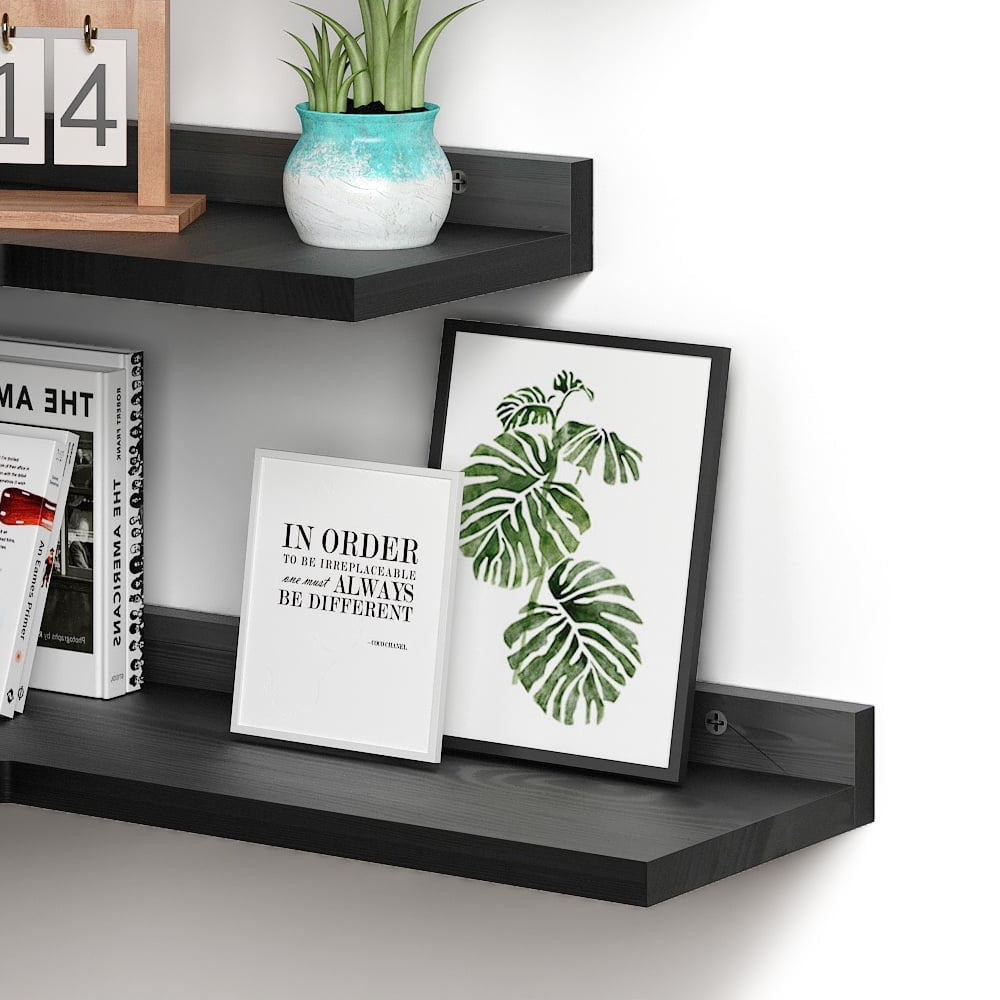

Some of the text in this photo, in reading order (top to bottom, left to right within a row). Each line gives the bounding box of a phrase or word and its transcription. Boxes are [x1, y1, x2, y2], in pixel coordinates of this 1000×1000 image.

[60, 64, 117, 146] 4
[281, 522, 419, 564] IN ORDER
[283, 554, 416, 580] TO BE IRREPLACEABLE
[20, 539, 45, 640] An Eames Primer
[277, 589, 413, 623] BE DIFFERENT
[282, 574, 414, 603] one must ALWAYS
